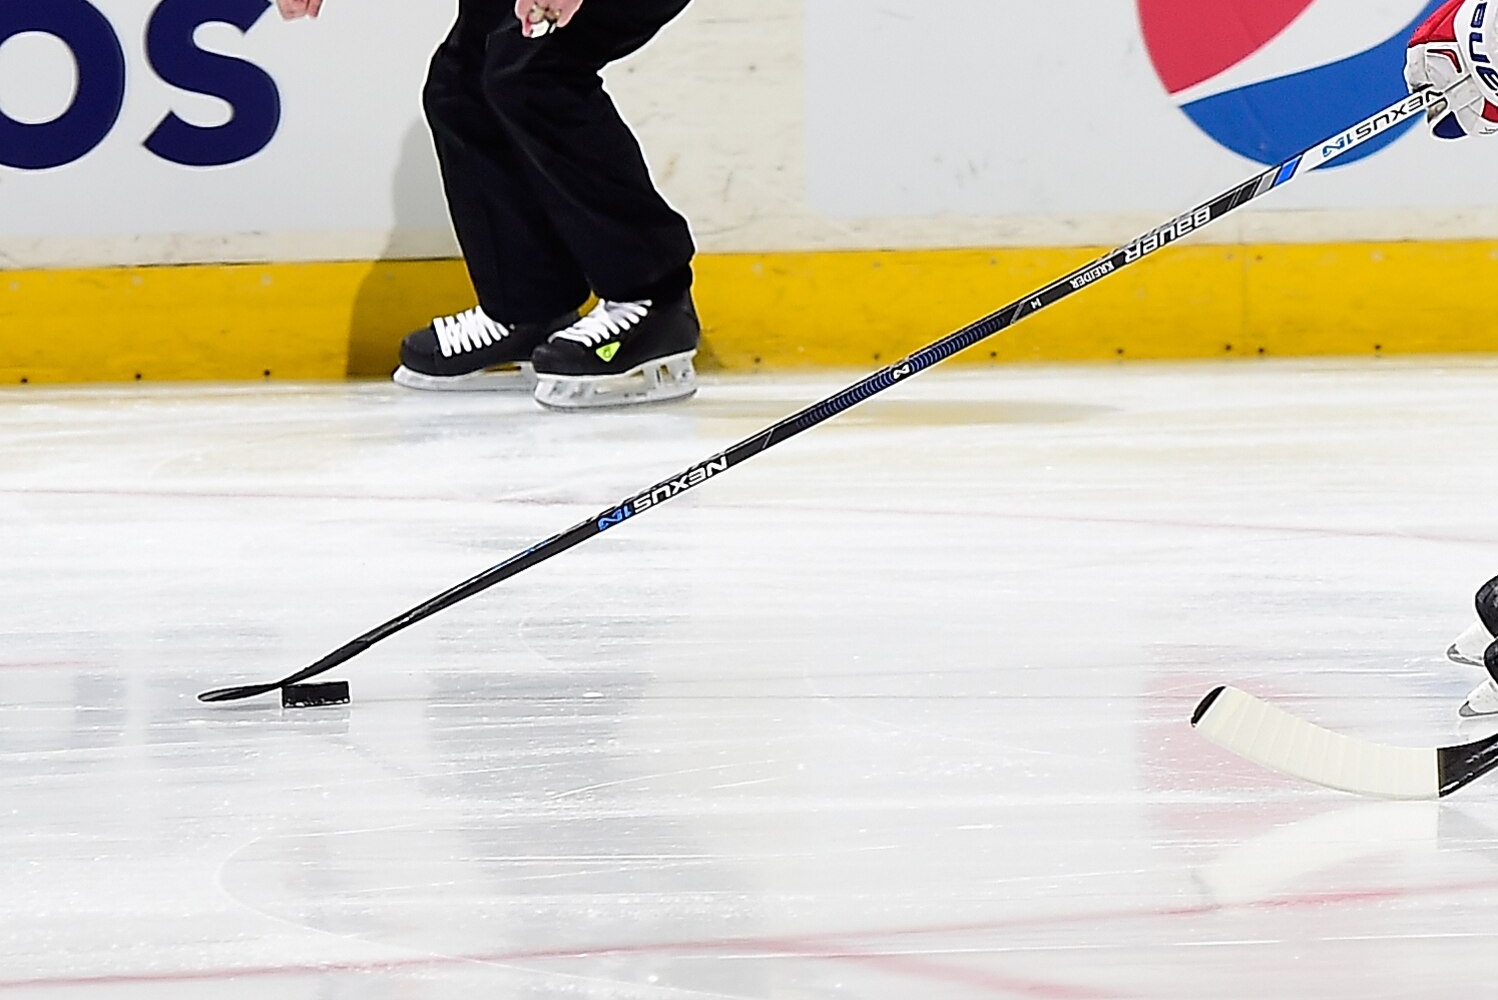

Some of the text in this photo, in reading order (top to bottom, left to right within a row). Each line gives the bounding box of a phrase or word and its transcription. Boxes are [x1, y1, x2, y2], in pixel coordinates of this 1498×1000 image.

[1356, 88, 1444, 140] NEXUS
[1123, 205, 1212, 265] BAUER
[1069, 260, 1115, 290] KREIDER
[632, 455, 729, 514] NEXUS
